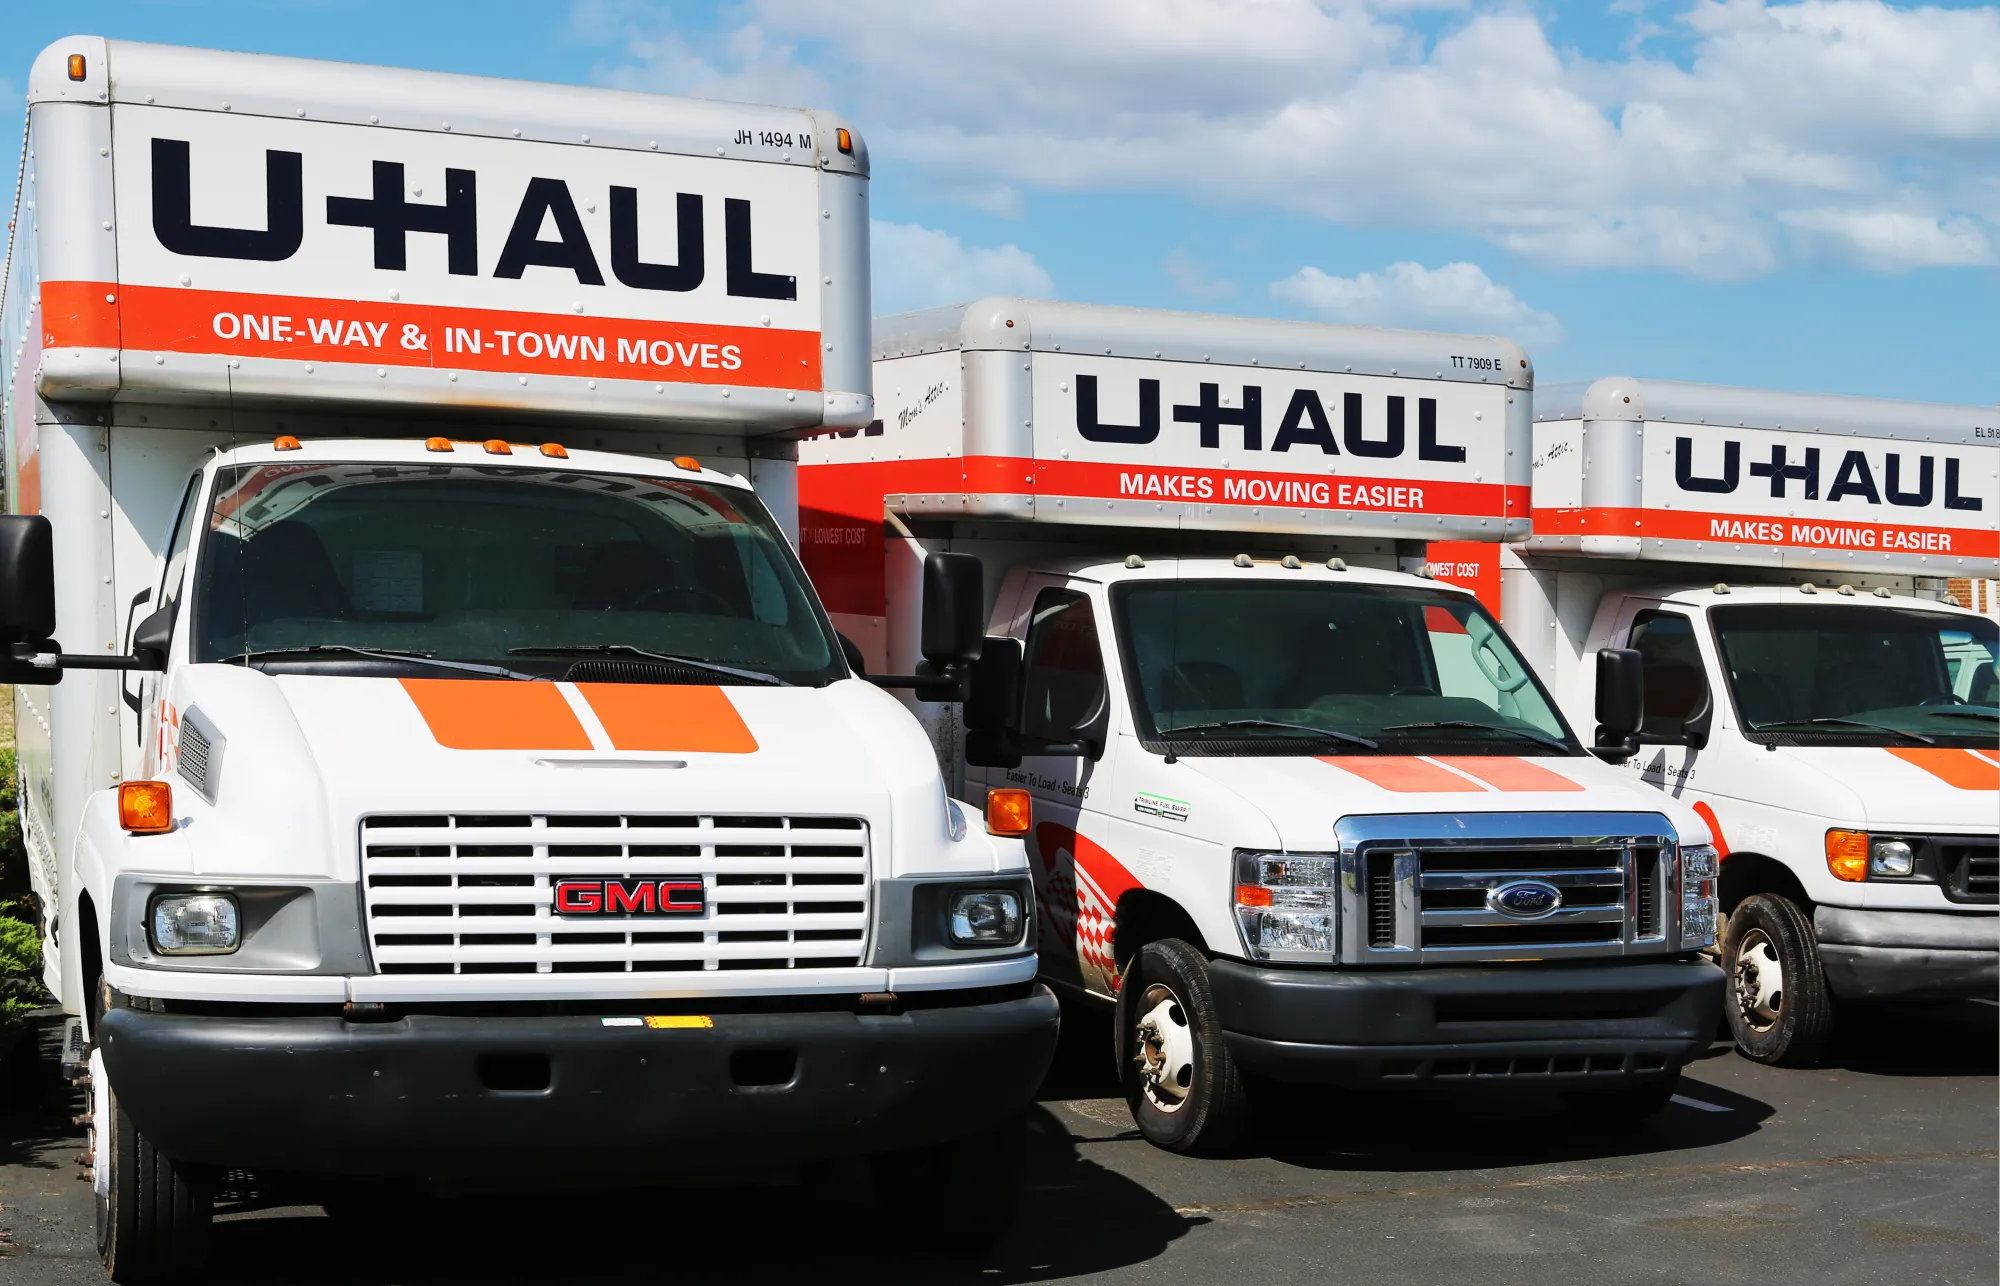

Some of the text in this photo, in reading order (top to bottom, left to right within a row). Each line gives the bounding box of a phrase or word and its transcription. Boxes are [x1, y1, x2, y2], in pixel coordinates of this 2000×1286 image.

[734, 130, 812, 149] JH 1494 M
[151, 137, 798, 301] U-HAUL
[212, 312, 743, 370] ONE-WAY & IN-TOWN MOVES
[1450, 355, 1502, 371] TT 7909 E
[898, 382, 944, 430] Mom's Attic
[1075, 374, 1467, 463] U-HAUL
[1975, 427, 1986, 438] EL
[1675, 436, 1983, 511] U-HAUL
[1120, 473, 1424, 509] MAKES MOVING EASIER
[814, 527, 844, 544] LOWEST
[845, 528, 866, 545] COST
[1710, 519, 1951, 551] MAKES MOVING EASIER
[1426, 562, 1480, 577] OWEST COST
[1006, 768, 1090, 799] Easier To Load Seats 3
[1633, 758, 1641, 770] To
[1643, 761, 1662, 774] Load
[1667, 765, 1688, 779] Seats
[1690, 769, 1696, 780] 3
[555, 881, 703, 913] GMC
[1513, 890, 1545, 906] Ford
